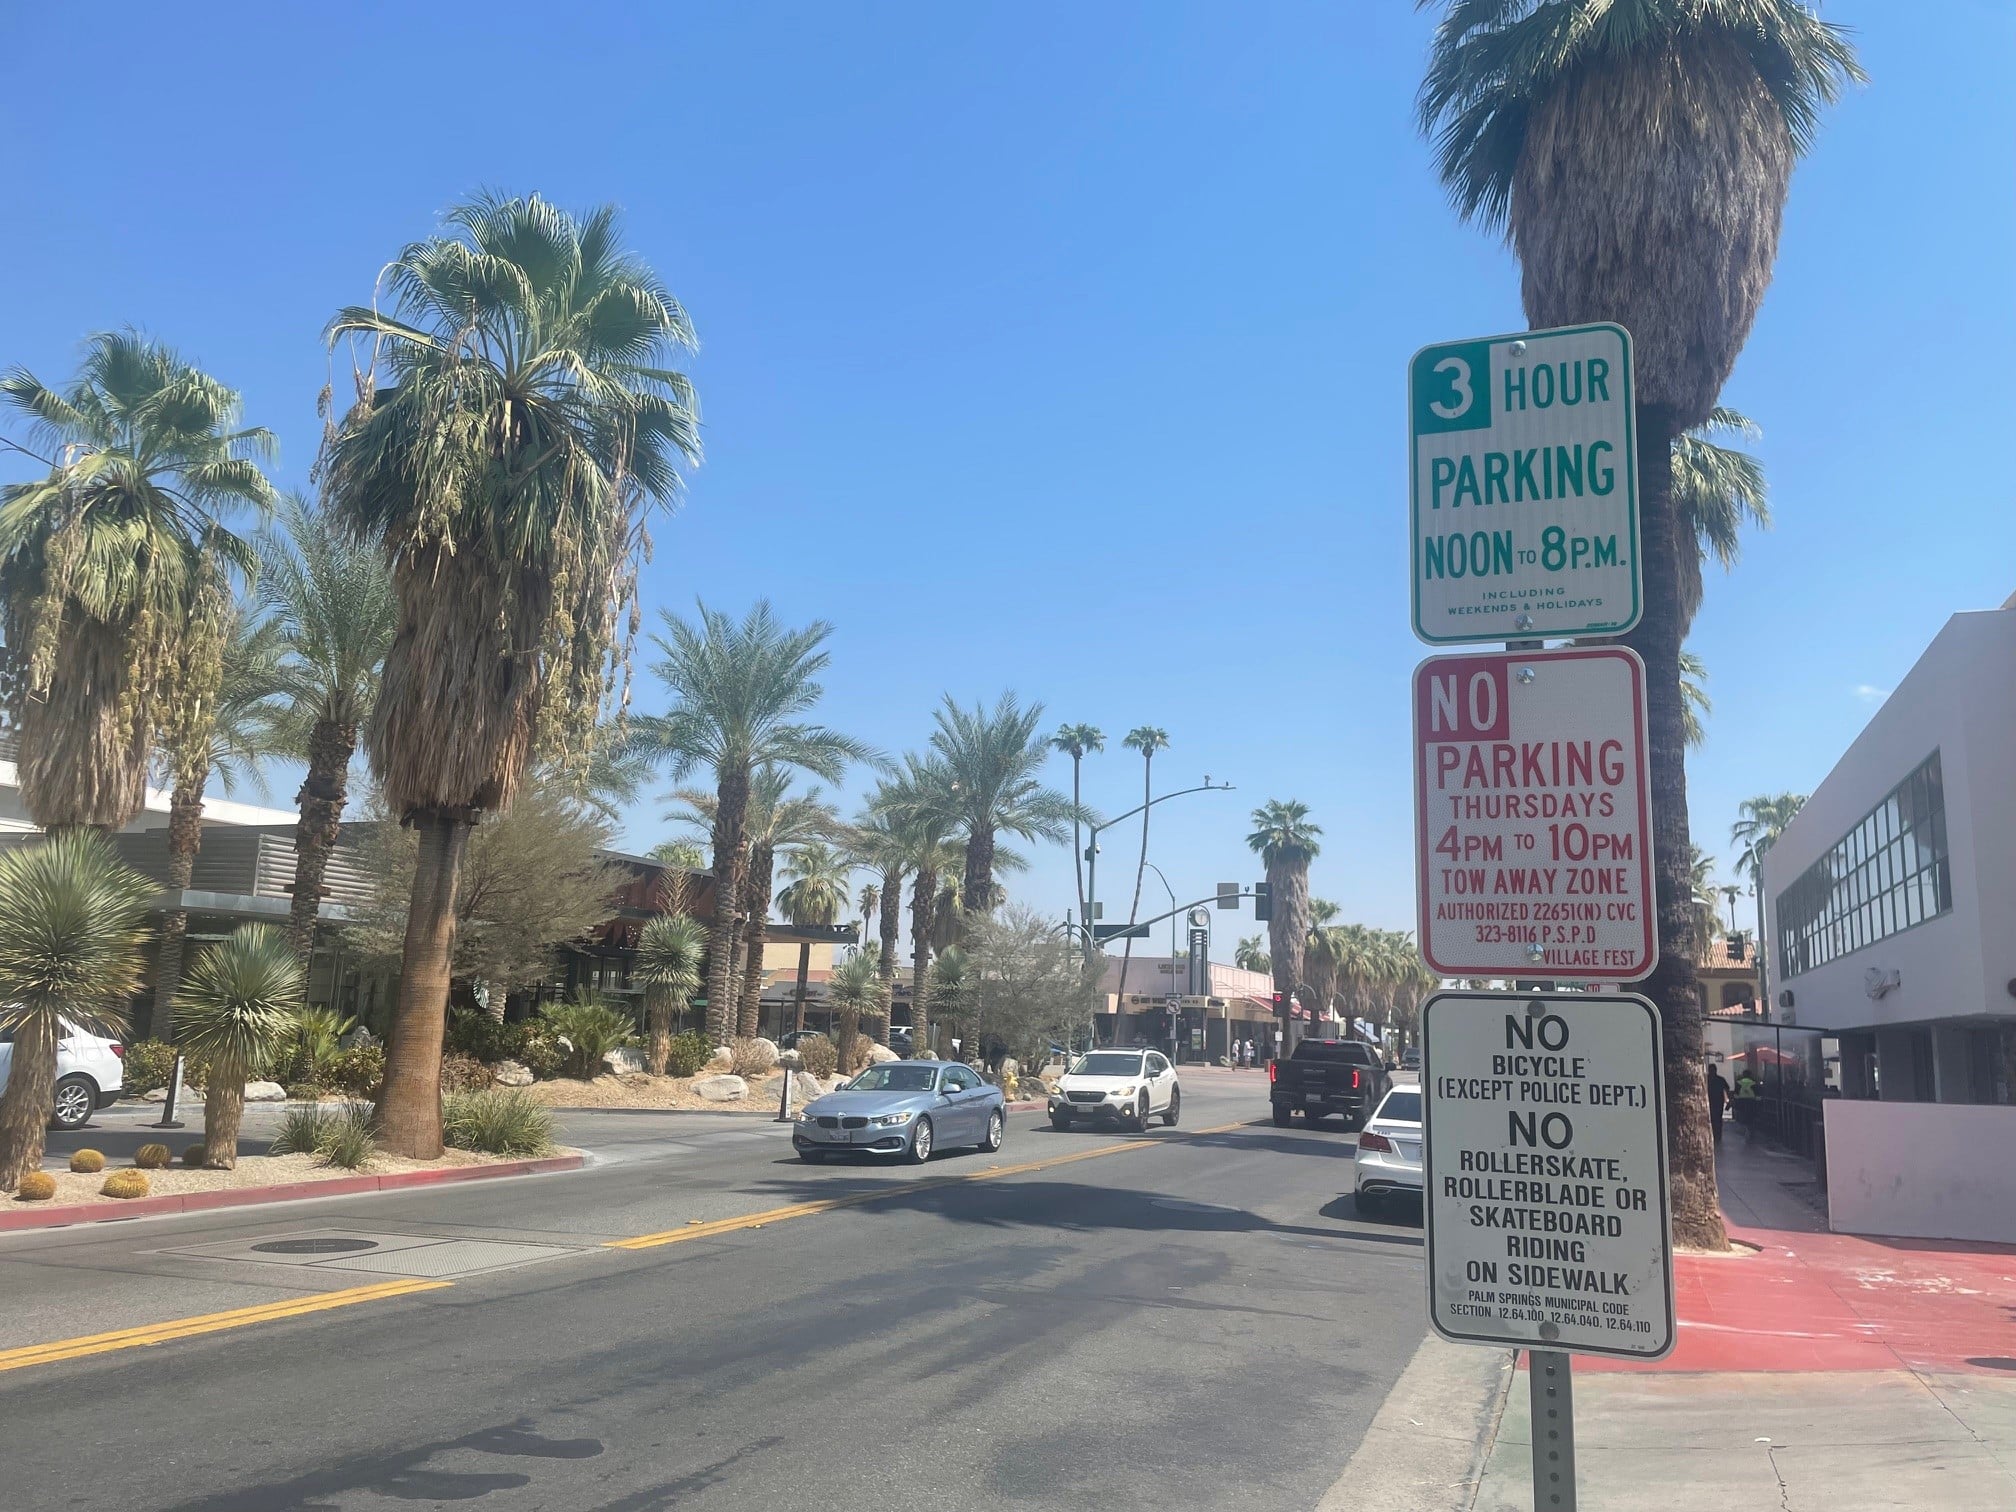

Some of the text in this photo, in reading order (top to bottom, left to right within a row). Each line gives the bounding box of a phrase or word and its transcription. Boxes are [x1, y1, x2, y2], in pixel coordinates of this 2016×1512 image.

[1429, 357, 1610, 419] 3 HOUR
[1431, 440, 1615, 509] PARKING
[1425, 529, 1514, 580] NOON
[1517, 550, 1537, 565] TO
[1447, 598, 1604, 616] WEEKENDS & HOLIDAYS
[1482, 587, 1566, 601] INCLUDING
[1431, 671, 1498, 732] NO
[1437, 739, 1625, 790] PARKING
[1449, 792, 1614, 819] THURSDAYS
[1435, 823, 1633, 862] 4PM TO 10PM
[1442, 868, 1628, 895] TOW AWAY ZONE
[1437, 902, 1636, 921] AUTHORIZED 22651(N) CVC
[1475, 925, 1537, 943] 323-8116
[1543, 949, 1635, 966] VILLAGE FEST
[1505, 1014, 1570, 1052] NO
[1492, 1054, 1586, 1078] BICYCLE
[1438, 1076, 1647, 1109] (EXCEPT POLICE DEPT.)
[1508, 1110, 1573, 1149] NO
[1460, 1150, 1628, 1184] ROLLERSKATE,
[1444, 1176, 1647, 1211] ROLLERBLADE OR
[1469, 1205, 1622, 1238] SKATEBOARD
[1507, 1236, 1585, 1263] RIDING
[1466, 1261, 1630, 1296] ON SIDEWALK
[1450, 1303, 1492, 1317] SECTION
[1605, 1318, 1651, 1333] 12.64.110
[1468, 1290, 1630, 1316] PALM SPRINGS MUNICIPAL CODE
